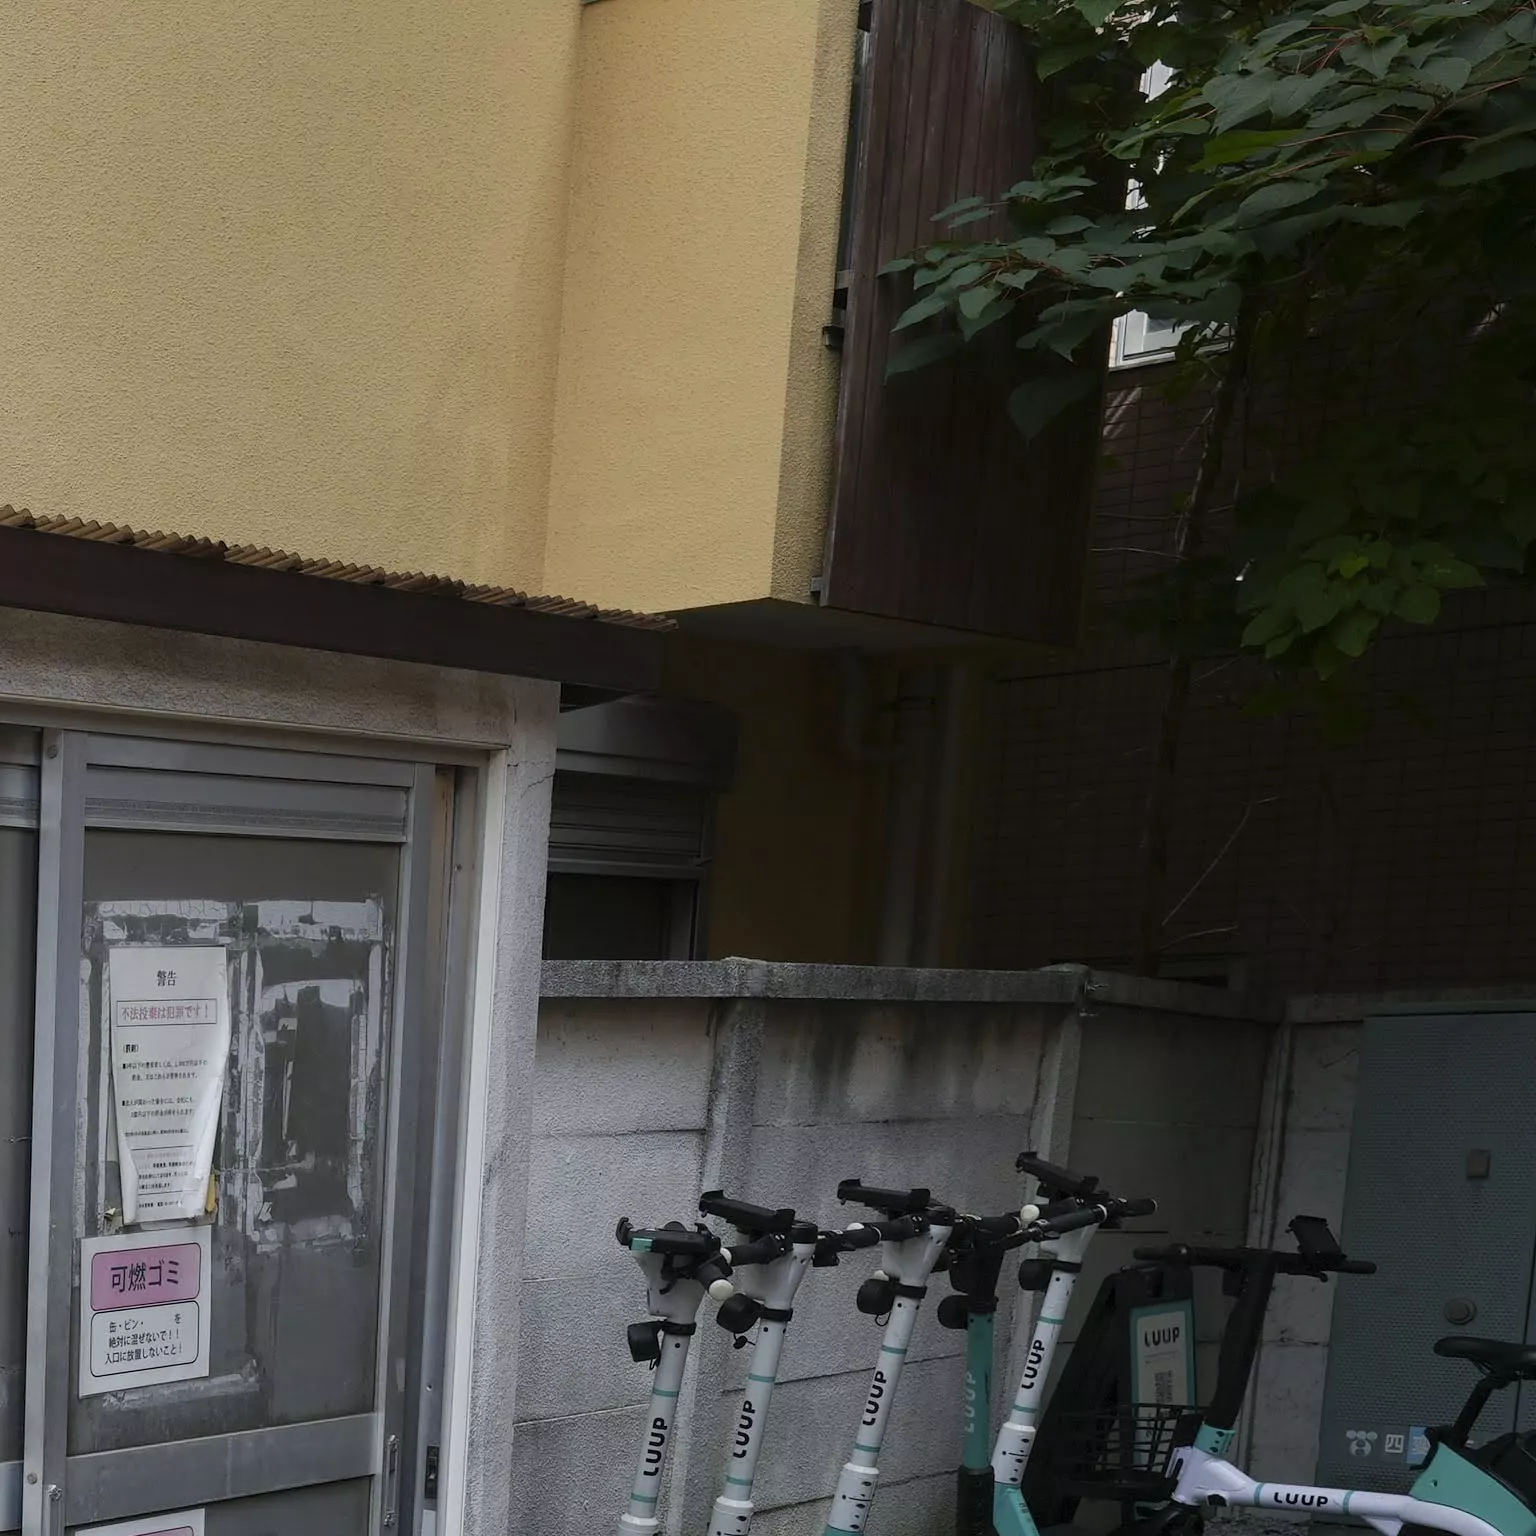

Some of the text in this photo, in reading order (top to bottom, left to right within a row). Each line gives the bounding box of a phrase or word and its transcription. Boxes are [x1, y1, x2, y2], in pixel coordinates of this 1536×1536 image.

[157, 970, 177, 987] 警告
[121, 1002, 208, 1020] 不法投棄は犯罪です！
[110, 1259, 180, 1293] 可燃ゴミ
[108, 1328, 180, 1349] 絶対に混ぜないで！！
[1143, 1325, 1180, 1348] LUUP
[105, 1343, 182, 1365] 入口に放置しないこと！
[1020, 1339, 1046, 1391] LUUP
[862, 1370, 888, 1427] LUUP
[733, 1399, 757, 1460] LUUP
[643, 1416, 669, 1478] LUUP
[1273, 1491, 1329, 1508] LUUP
